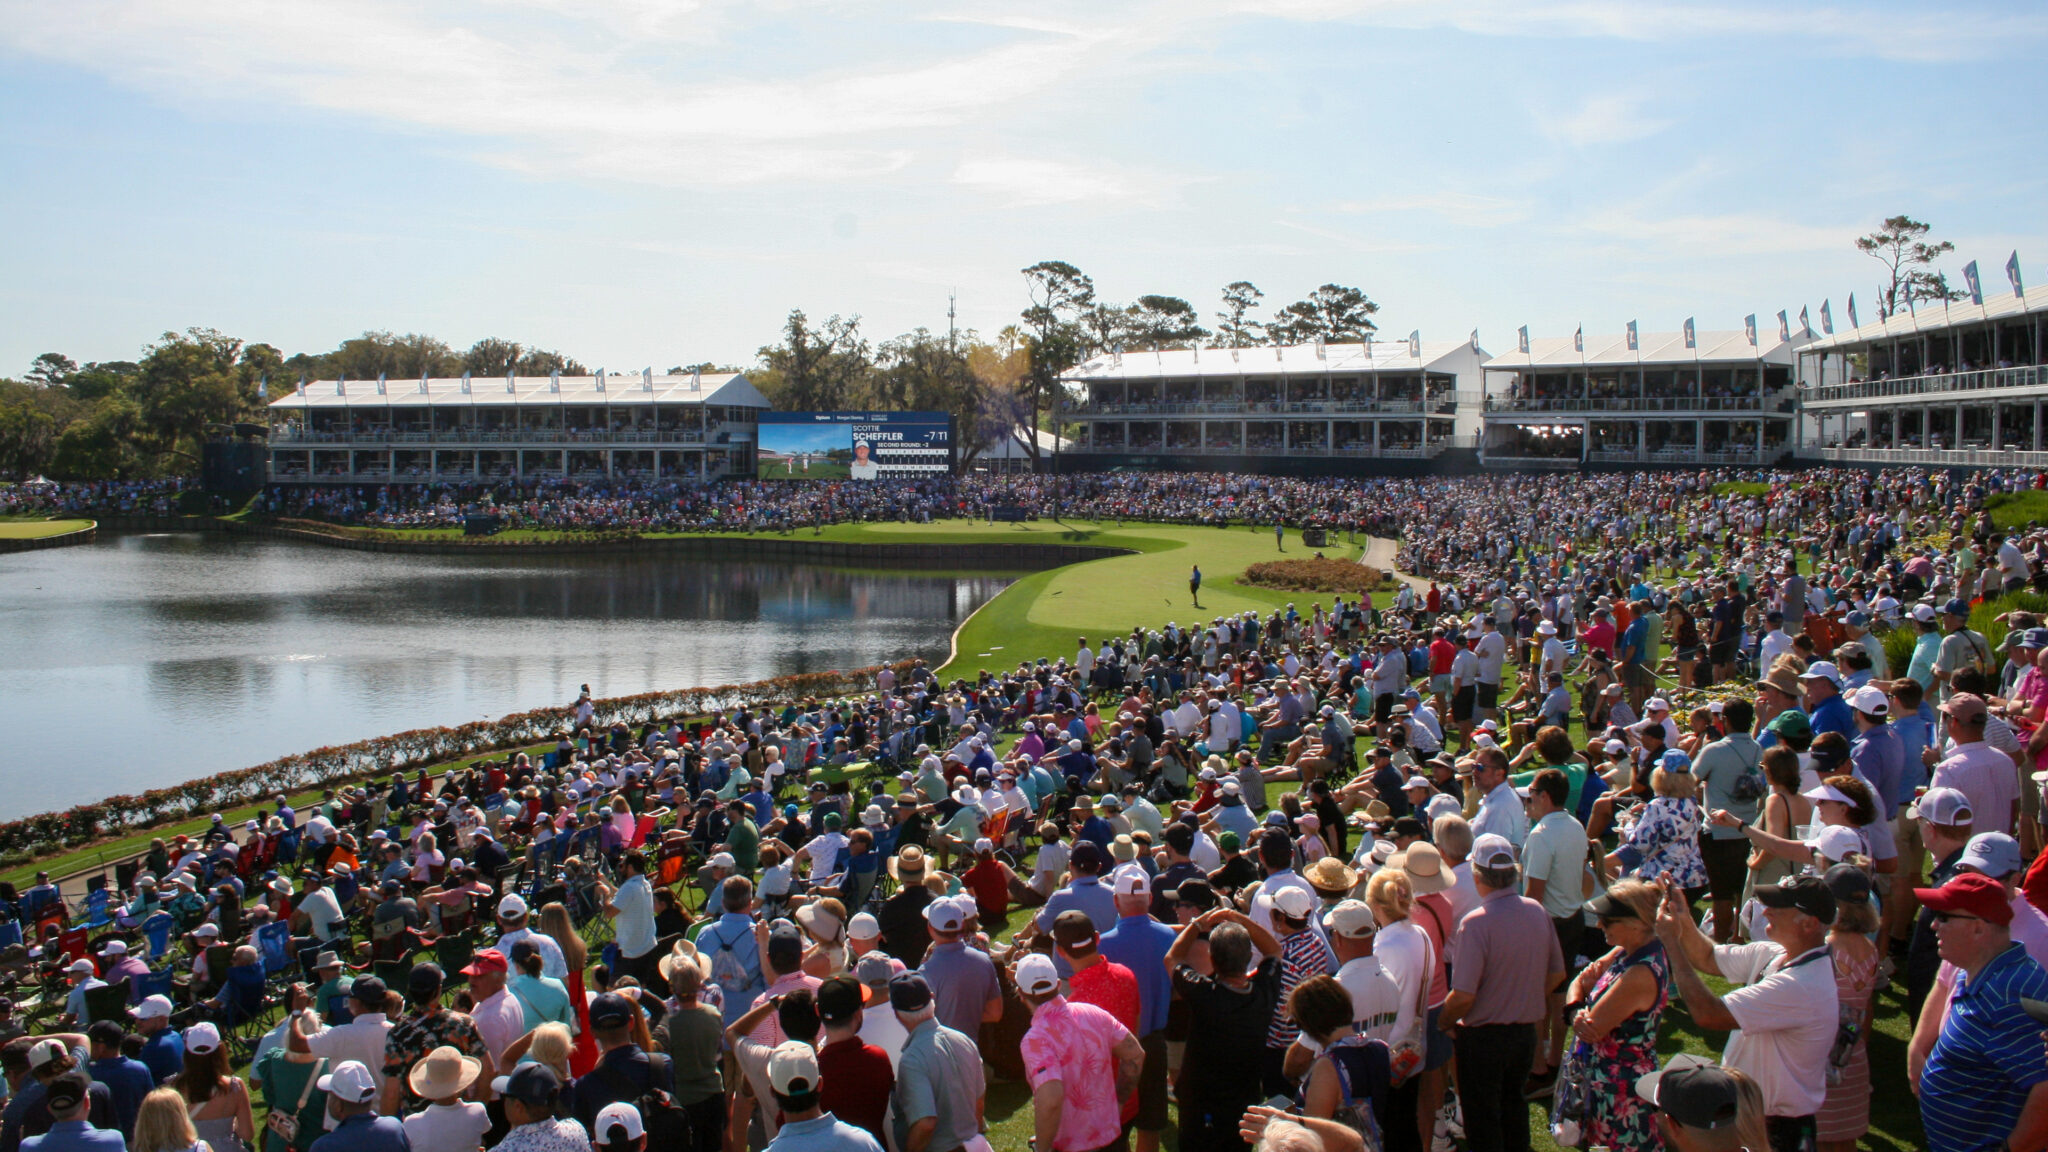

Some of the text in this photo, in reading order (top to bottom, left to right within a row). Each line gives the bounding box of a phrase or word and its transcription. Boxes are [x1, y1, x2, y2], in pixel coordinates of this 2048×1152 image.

[852, 432, 903, 441] SCHEFFLER
[923, 431, 948, 440] -7 T1
